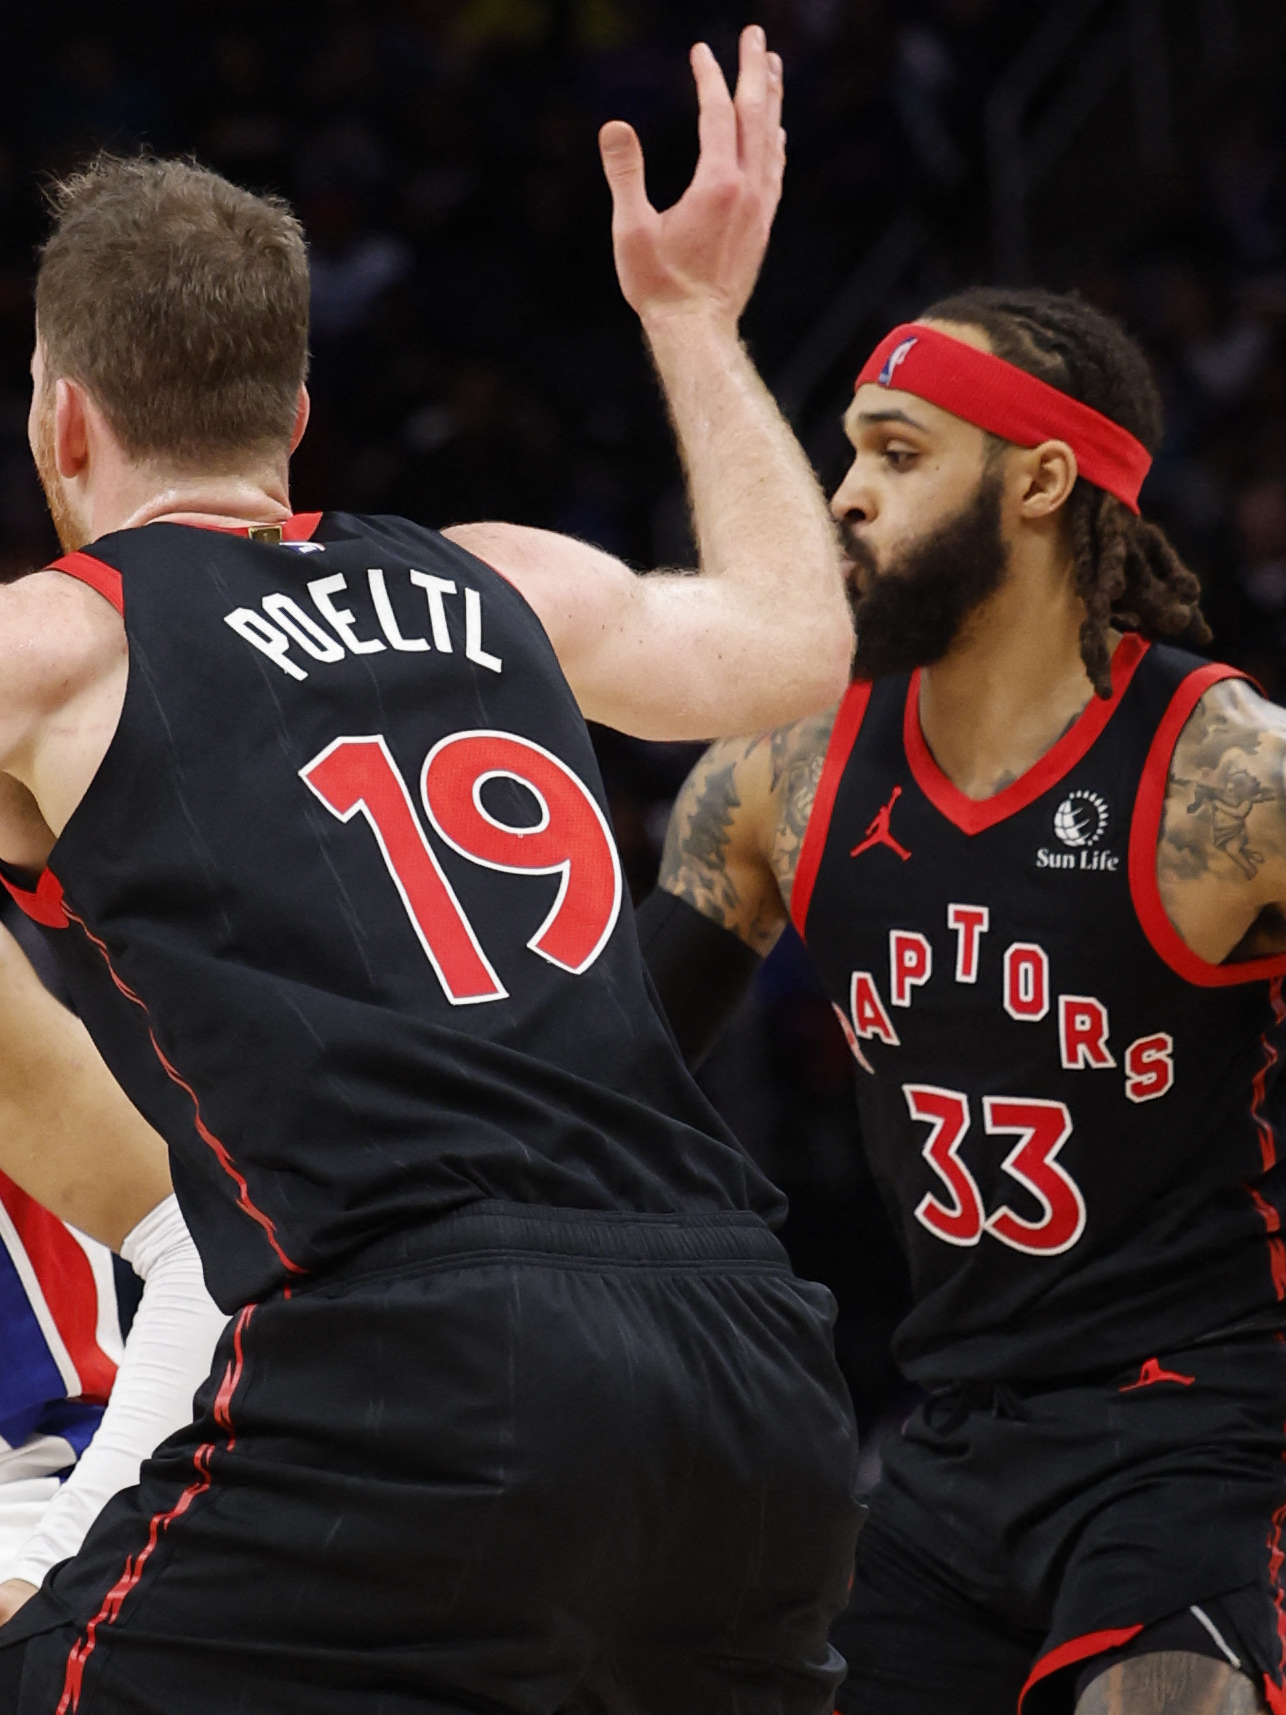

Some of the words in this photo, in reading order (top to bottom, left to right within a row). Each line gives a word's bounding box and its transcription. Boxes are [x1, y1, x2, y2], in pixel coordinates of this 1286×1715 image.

[224, 569, 502, 681] POELTL
[299, 729, 622, 1005] 19
[1035, 847, 1075, 868] Sun
[1079, 849, 1120, 871] Life
[832, 903, 1174, 1103] APTORS
[902, 1083, 1086, 1256] 33
